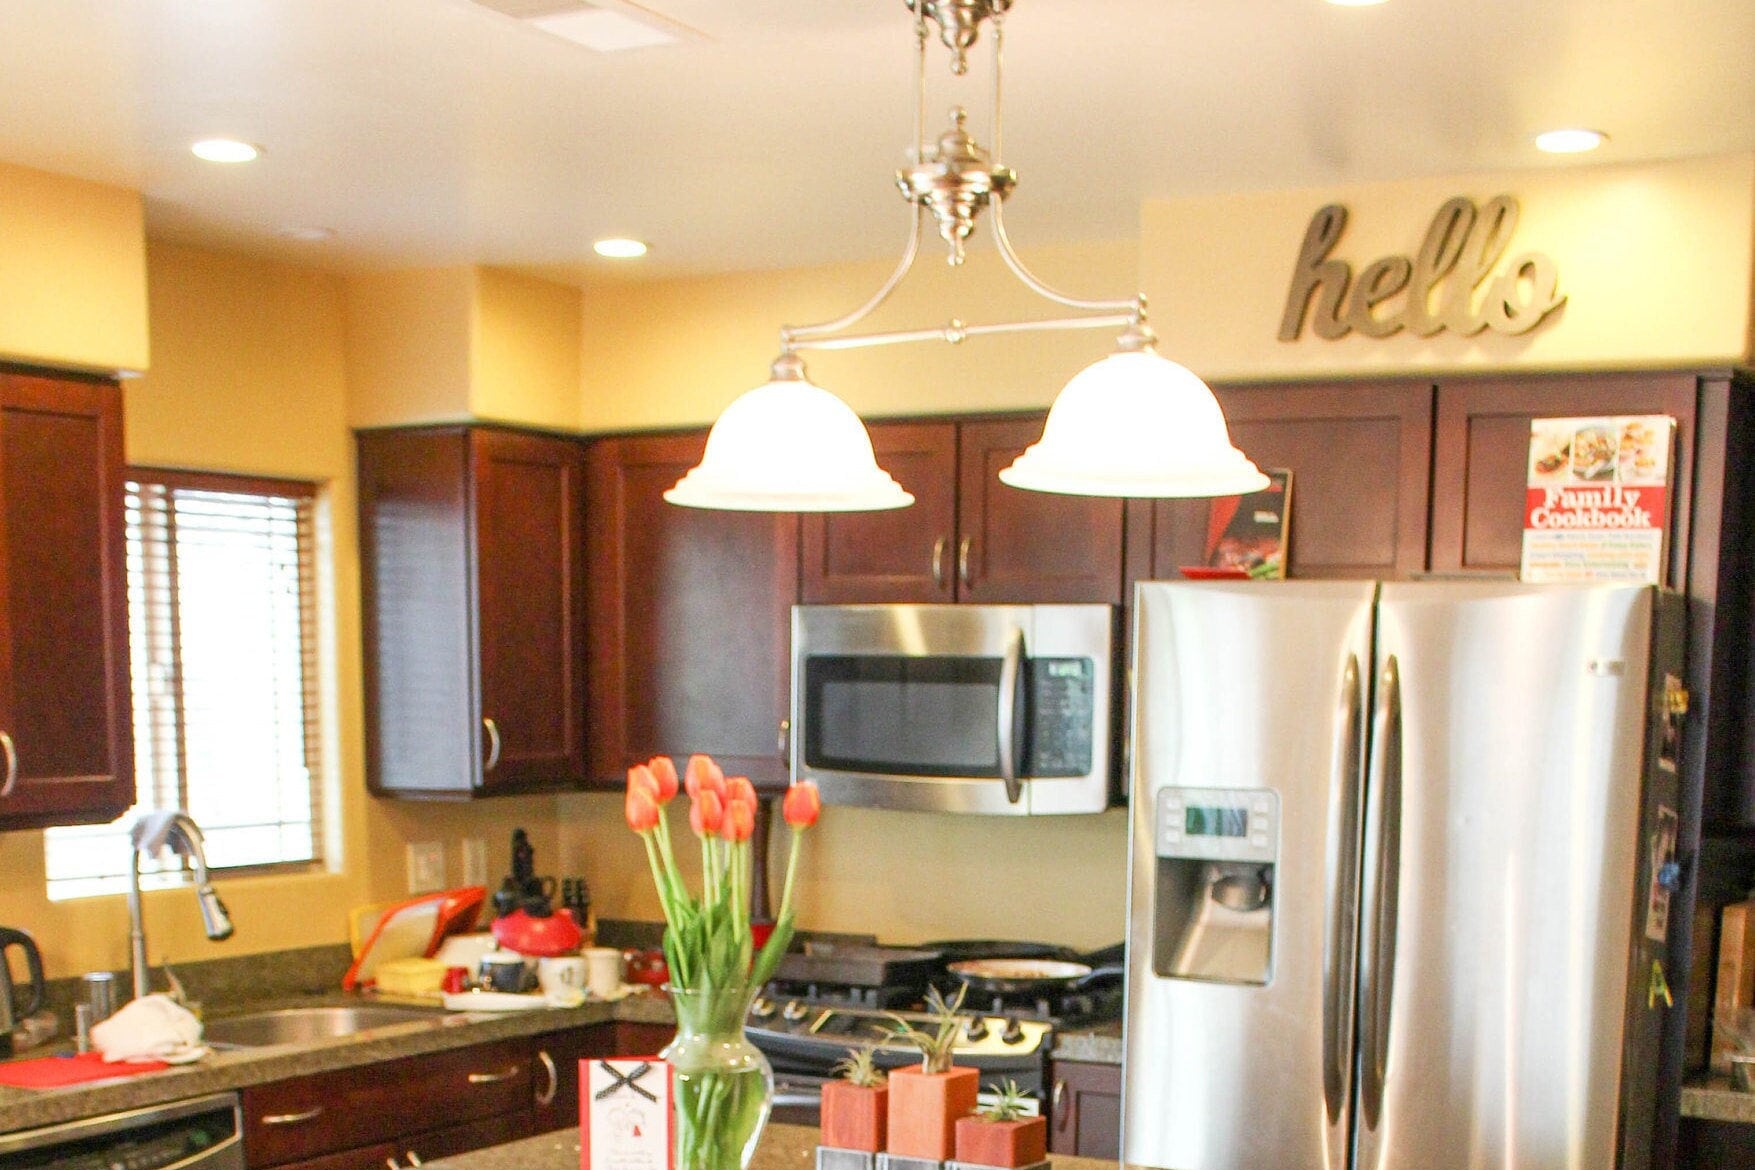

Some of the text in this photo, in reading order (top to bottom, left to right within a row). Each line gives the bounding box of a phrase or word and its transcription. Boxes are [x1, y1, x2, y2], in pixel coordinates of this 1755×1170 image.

[1278, 195, 1568, 342] hello
[1543, 486, 1641, 514] Family
[1530, 507, 1652, 529] Cookbook
